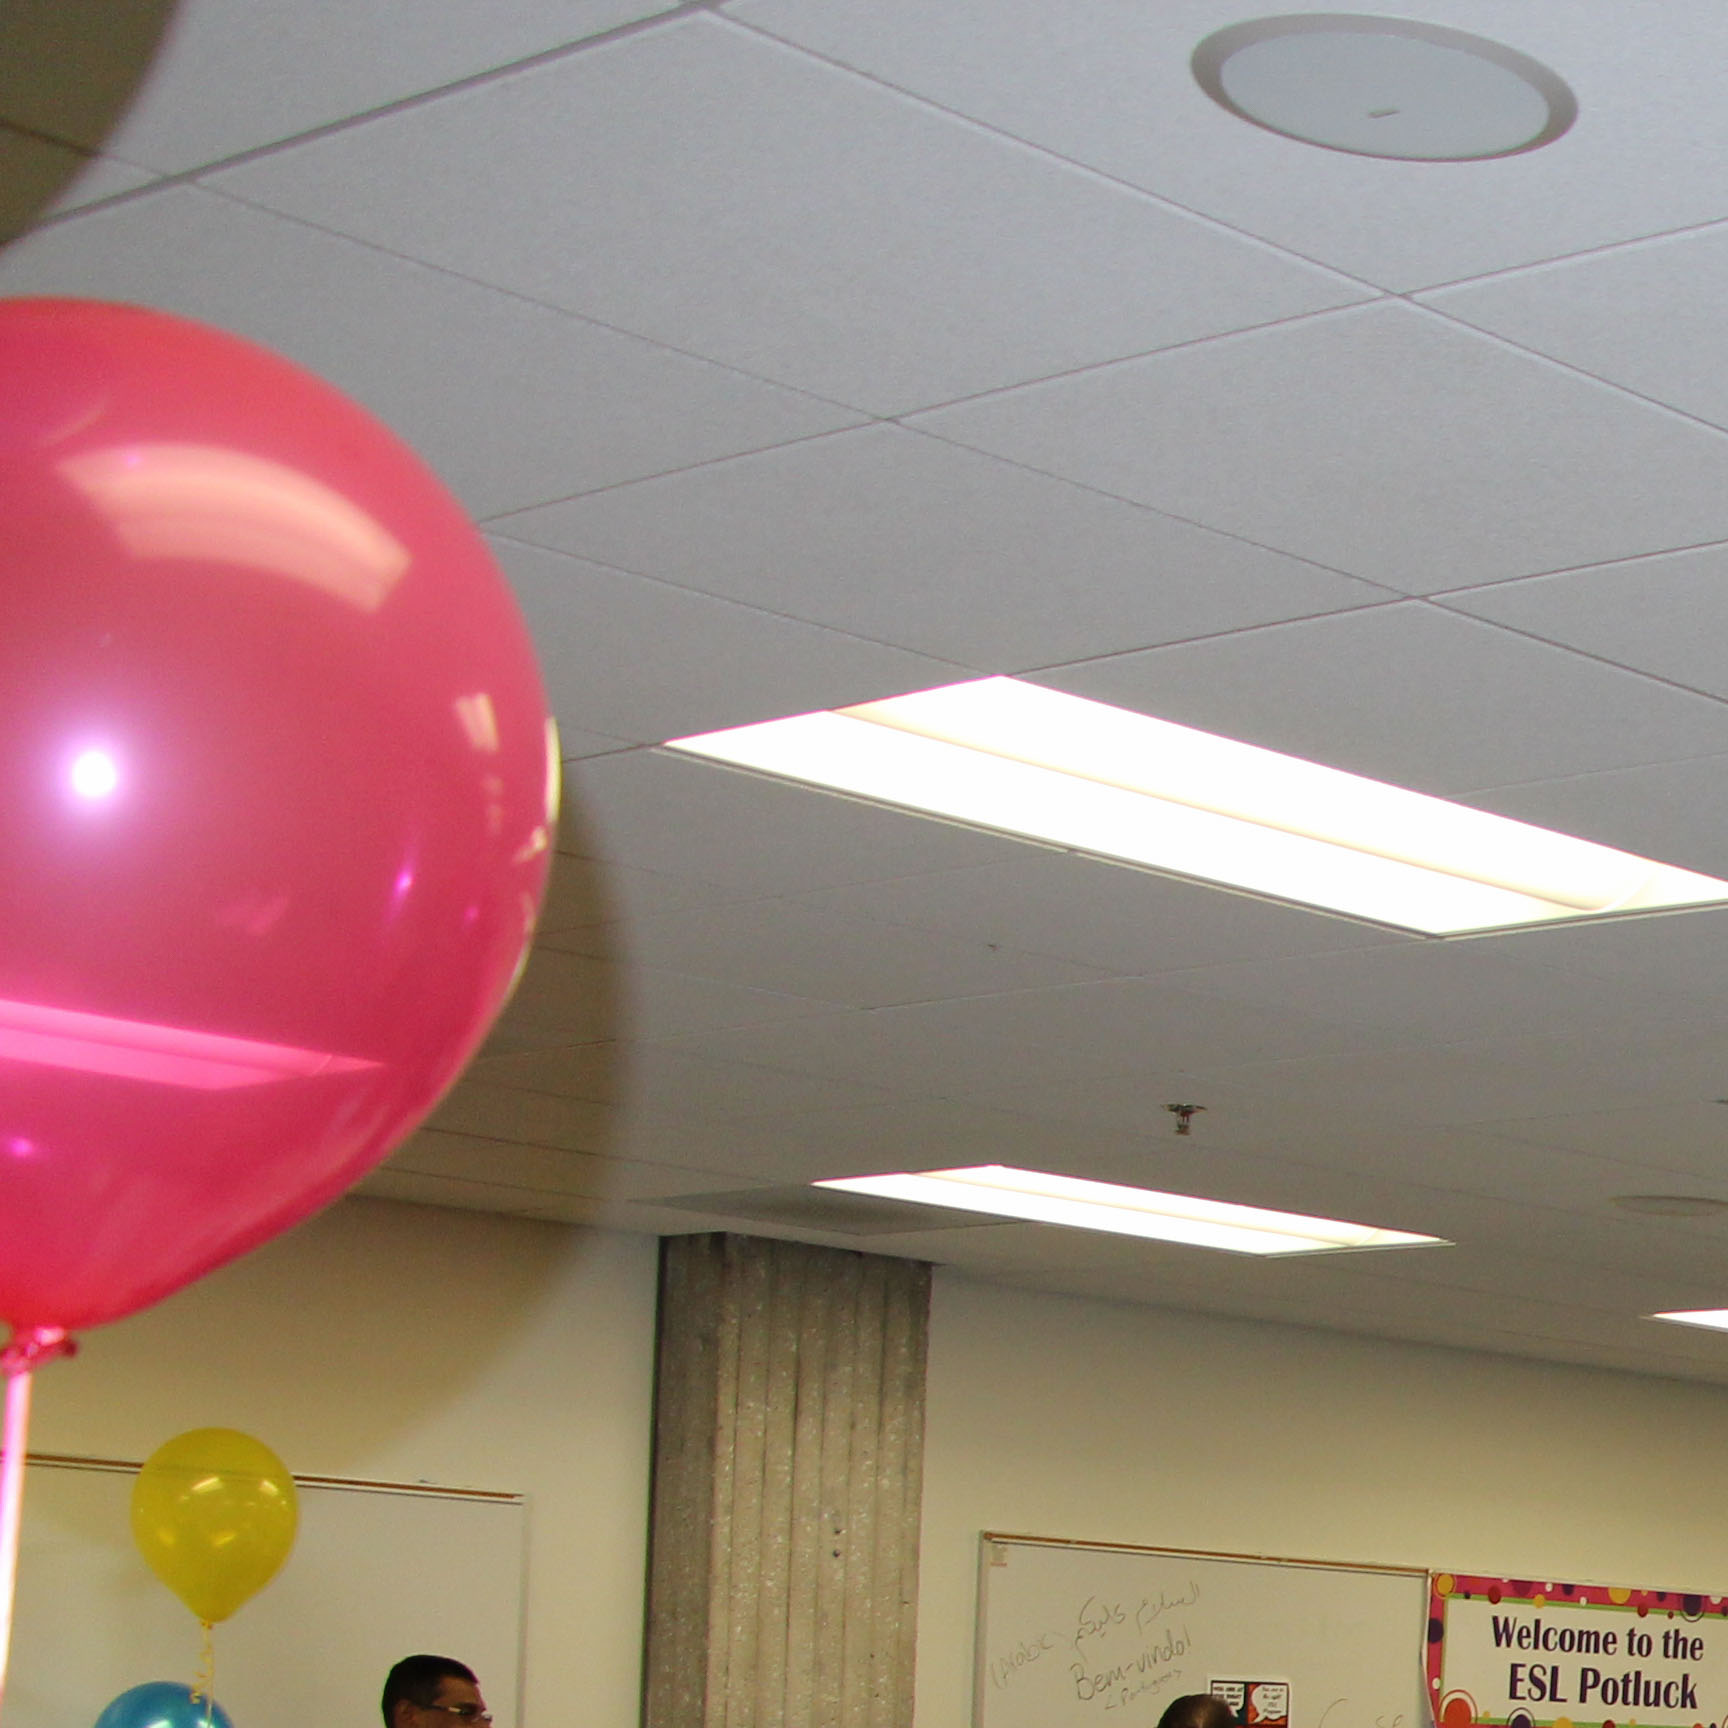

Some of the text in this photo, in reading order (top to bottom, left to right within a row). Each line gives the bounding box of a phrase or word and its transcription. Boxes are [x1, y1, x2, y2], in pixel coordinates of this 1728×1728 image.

[1491, 1614, 1704, 1660] Welcome to the
[1508, 1662, 1698, 1709] ESL Potluck
